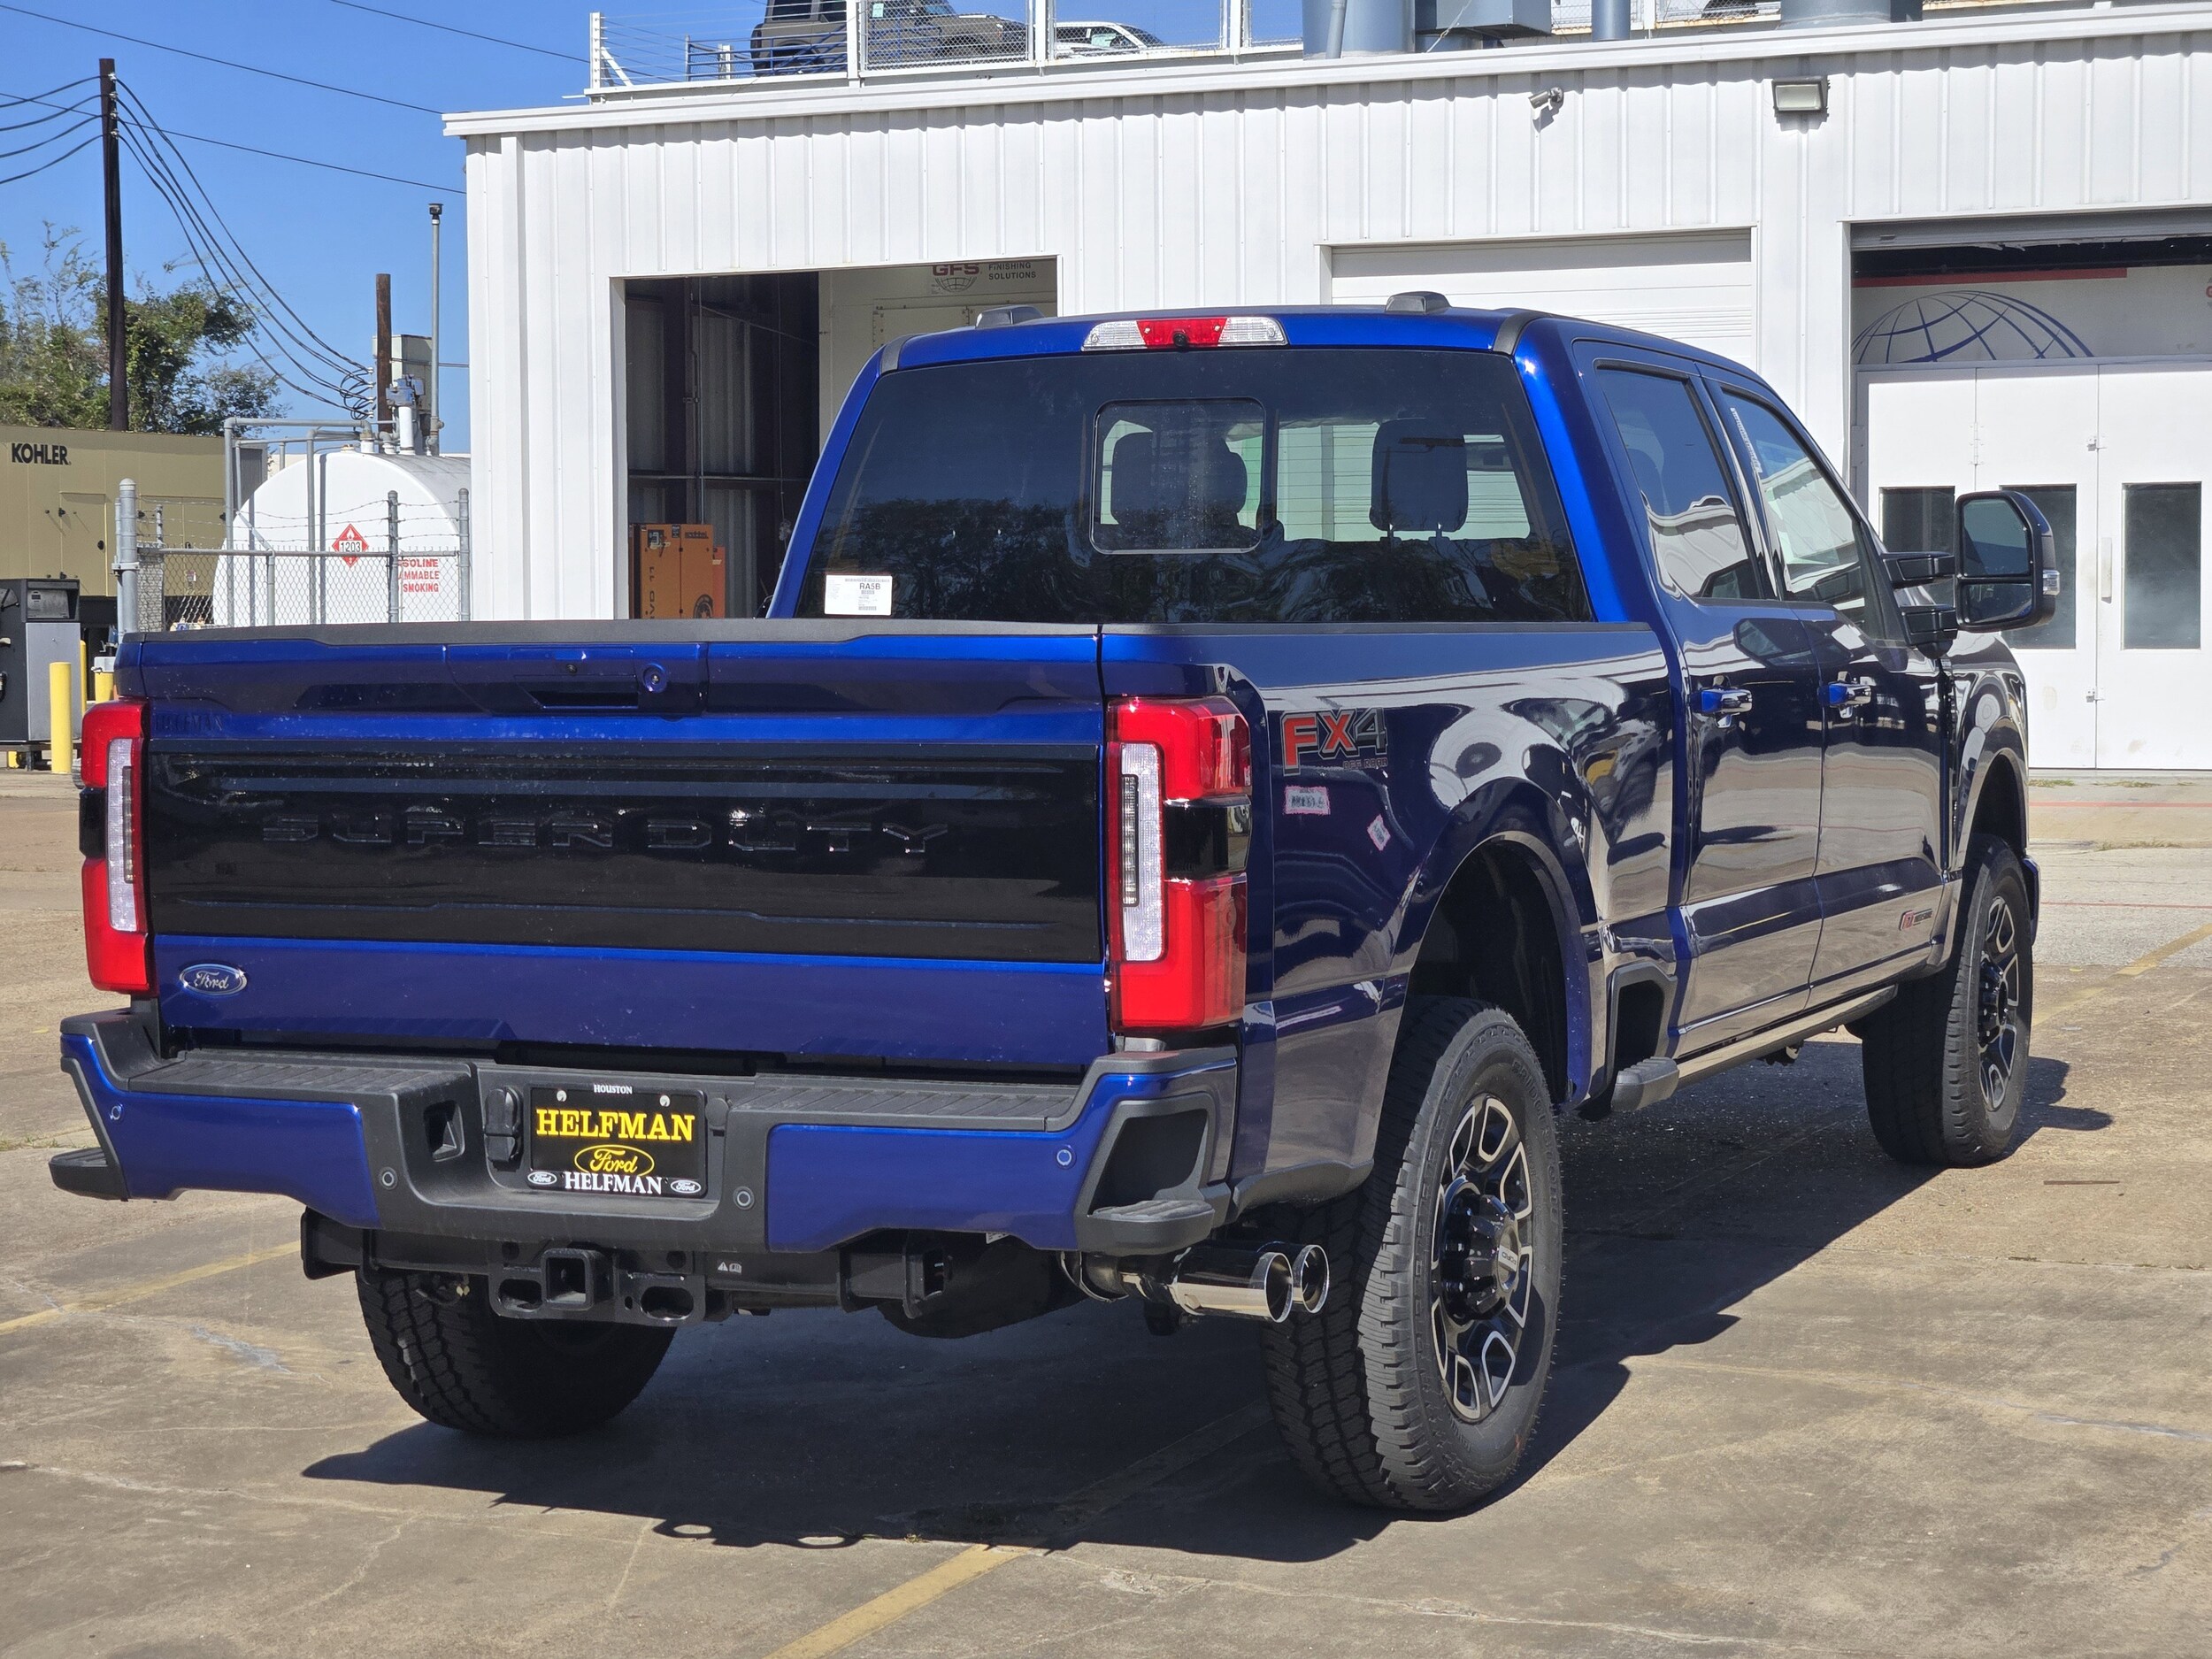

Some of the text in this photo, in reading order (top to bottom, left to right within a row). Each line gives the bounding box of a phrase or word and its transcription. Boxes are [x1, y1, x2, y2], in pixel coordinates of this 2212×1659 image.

[933, 264, 979, 276] GFS
[988, 262, 1032, 271] FINISHING
[988, 271, 1037, 280] SOLUTIONS
[12, 442, 69, 465] KOHLER
[341, 541, 361, 552] 1203
[403, 558, 439, 567] SOLINE
[403, 583, 439, 592] SMOKING
[1281, 708, 1387, 776] FX4
[1343, 759, 1362, 769] OFF
[263, 814, 948, 853] SUPER DUTY
[594, 1084, 633, 1094] HOUSTON
[536, 1109, 695, 1141] HELFMAN
[589, 1148, 638, 1174] Ford
[564, 1171, 662, 1194] HELFMAN
